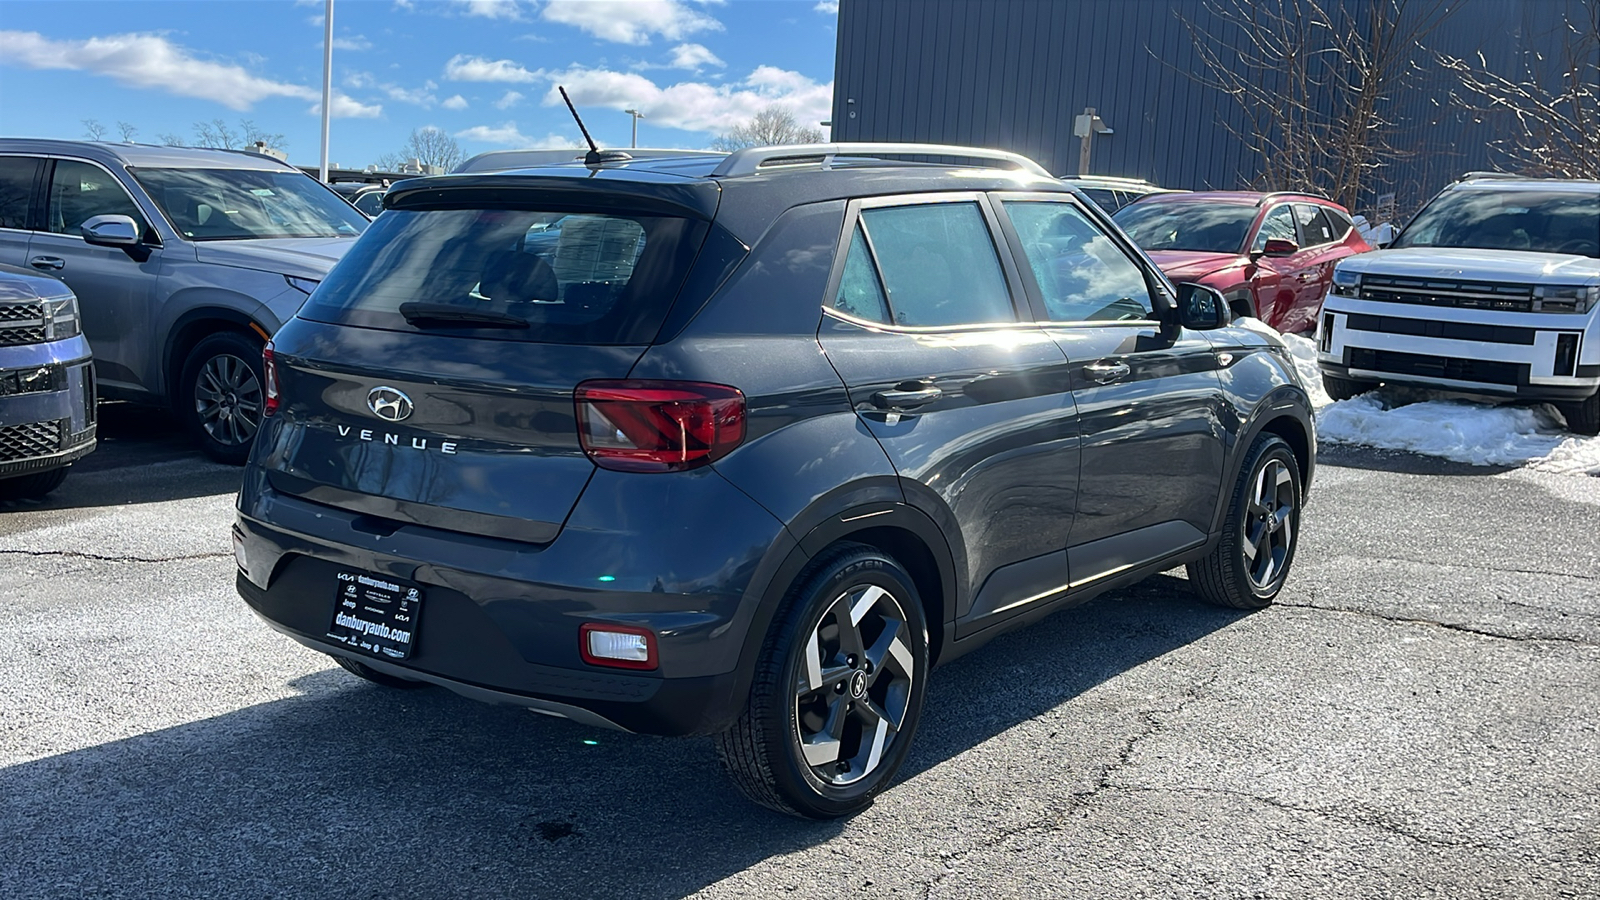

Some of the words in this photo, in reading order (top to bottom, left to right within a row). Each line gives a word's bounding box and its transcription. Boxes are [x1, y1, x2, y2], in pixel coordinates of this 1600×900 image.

[338, 425, 457, 454] VENUE
[835, 560, 883, 580] NEXEN
[342, 599, 356, 609] Jeep
[335, 611, 411, 644] danburyauto.com
[360, 641, 372, 650] Jeep
